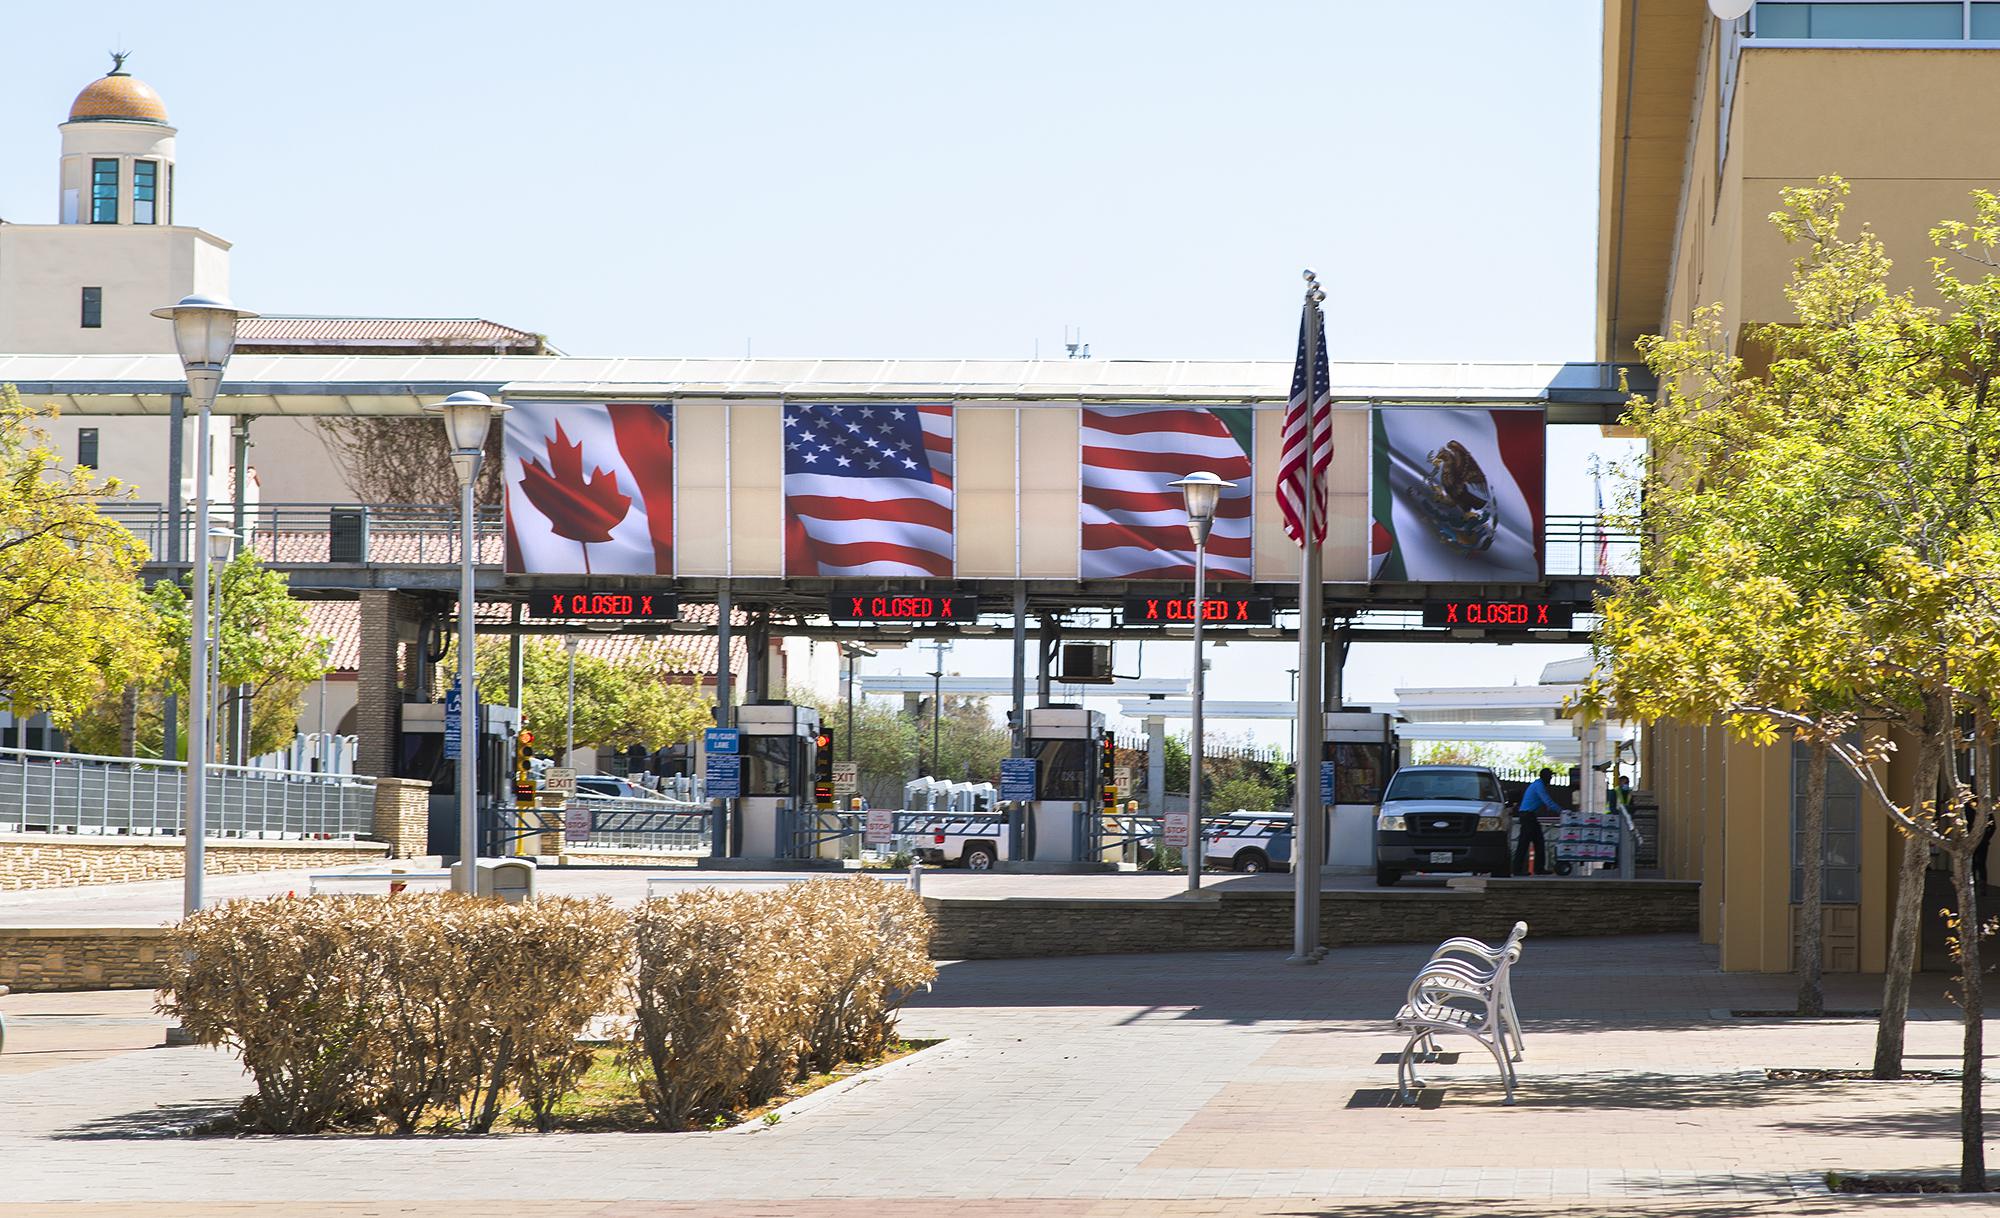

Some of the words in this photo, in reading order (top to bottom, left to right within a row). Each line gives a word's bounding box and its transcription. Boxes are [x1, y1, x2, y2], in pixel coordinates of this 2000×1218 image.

[552, 594, 564, 614] X
[571, 594, 633, 615] CLOSED
[641, 595, 653, 615] X
[852, 597, 863, 617] X
[871, 597, 933, 618] CLOSED
[941, 598, 952, 617] X
[1146, 599, 1159, 619] X
[1166, 599, 1229, 620] CLOSED
[1236, 600, 1248, 620] X
[1447, 603, 1458, 623] X
[1467, 603, 1529, 624] CLOSED
[1537, 604, 1549, 624] X
[831, 772, 856, 782] EXIT
[548, 778, 574, 788] EXIT
[567, 821, 588, 829] STOP
[869, 822, 890, 831] STOP
[1166, 826, 1187, 834] STOP
